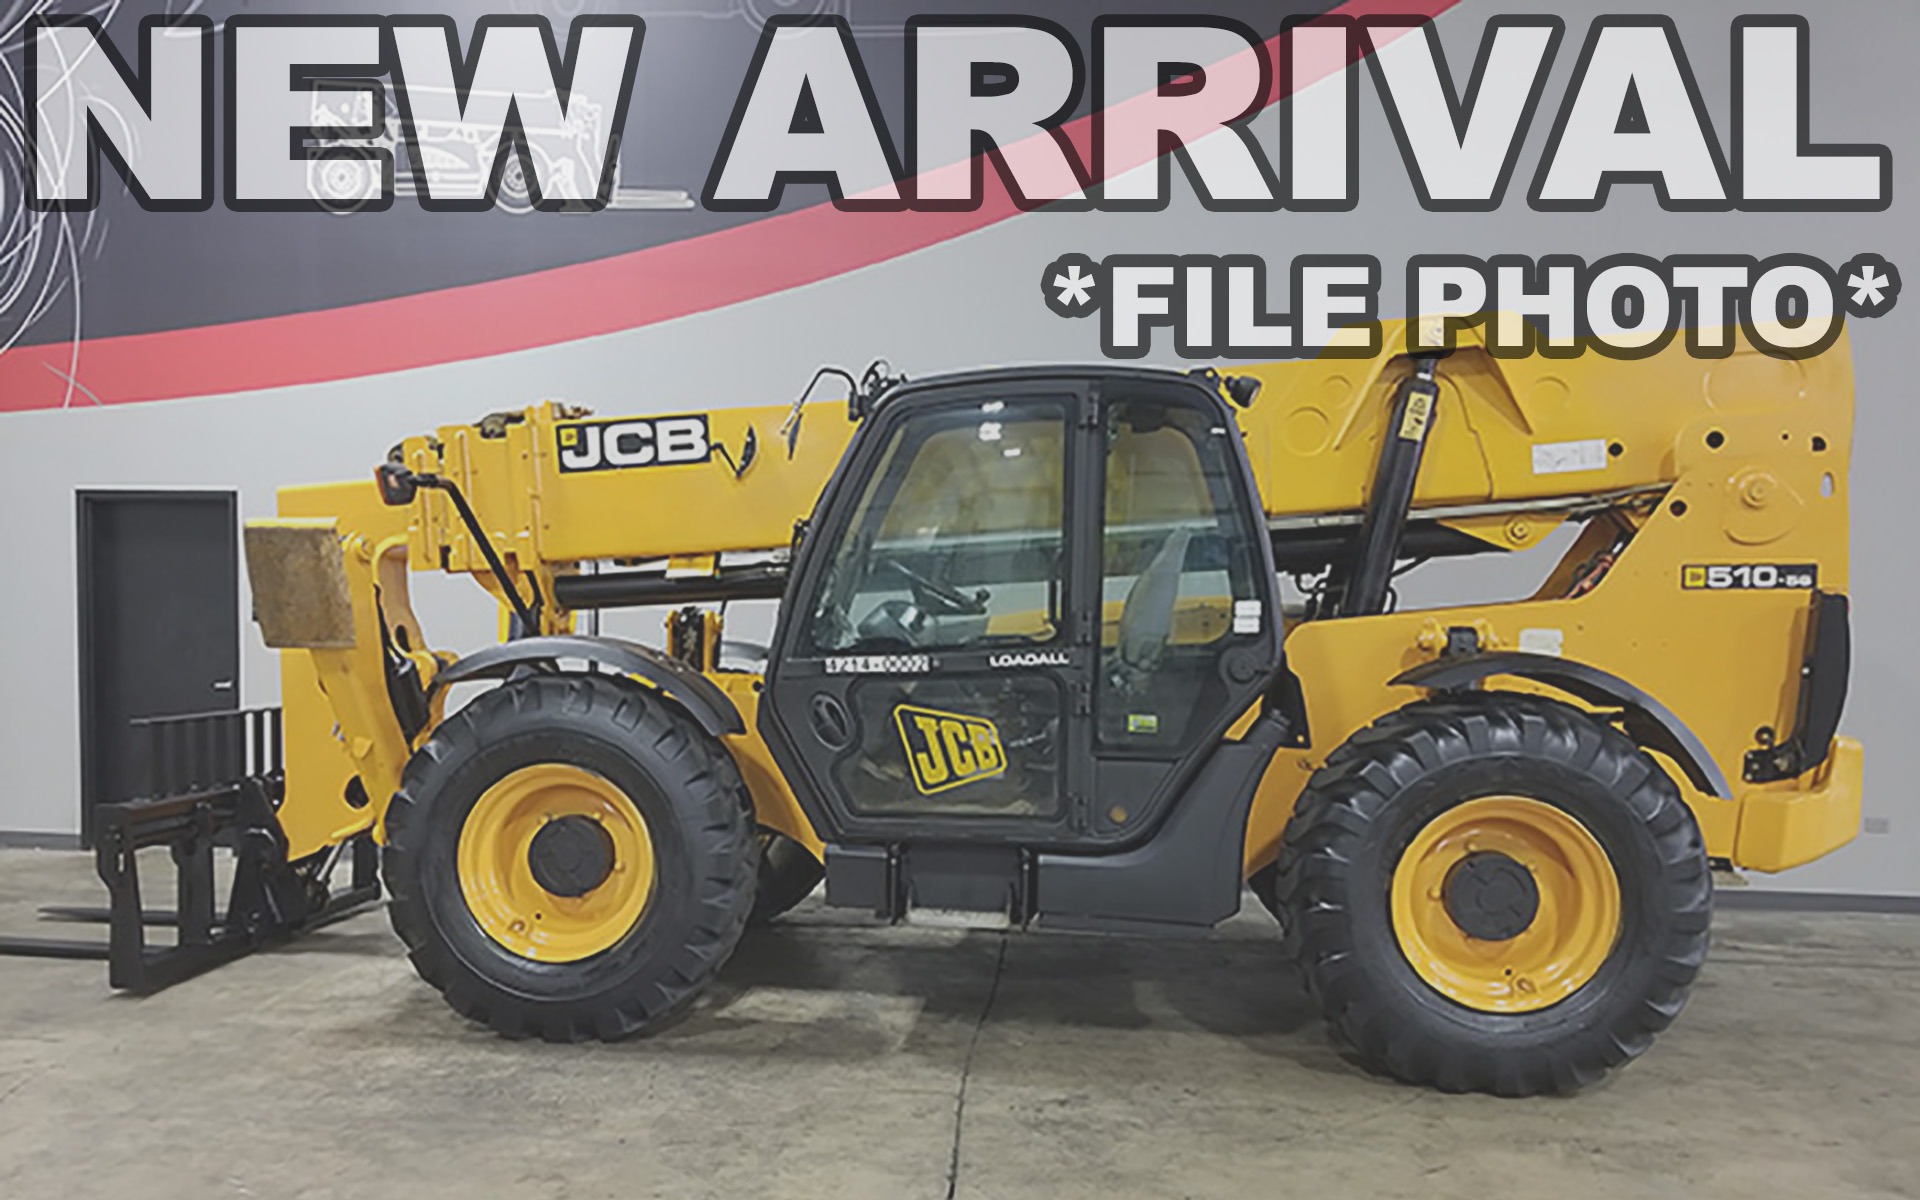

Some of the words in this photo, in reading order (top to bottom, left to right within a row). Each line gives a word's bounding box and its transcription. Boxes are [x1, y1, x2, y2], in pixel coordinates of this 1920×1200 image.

[561, 419, 708, 469] JCB
[989, 652, 1070, 668] LOADALL
[913, 714, 998, 785] JCB
